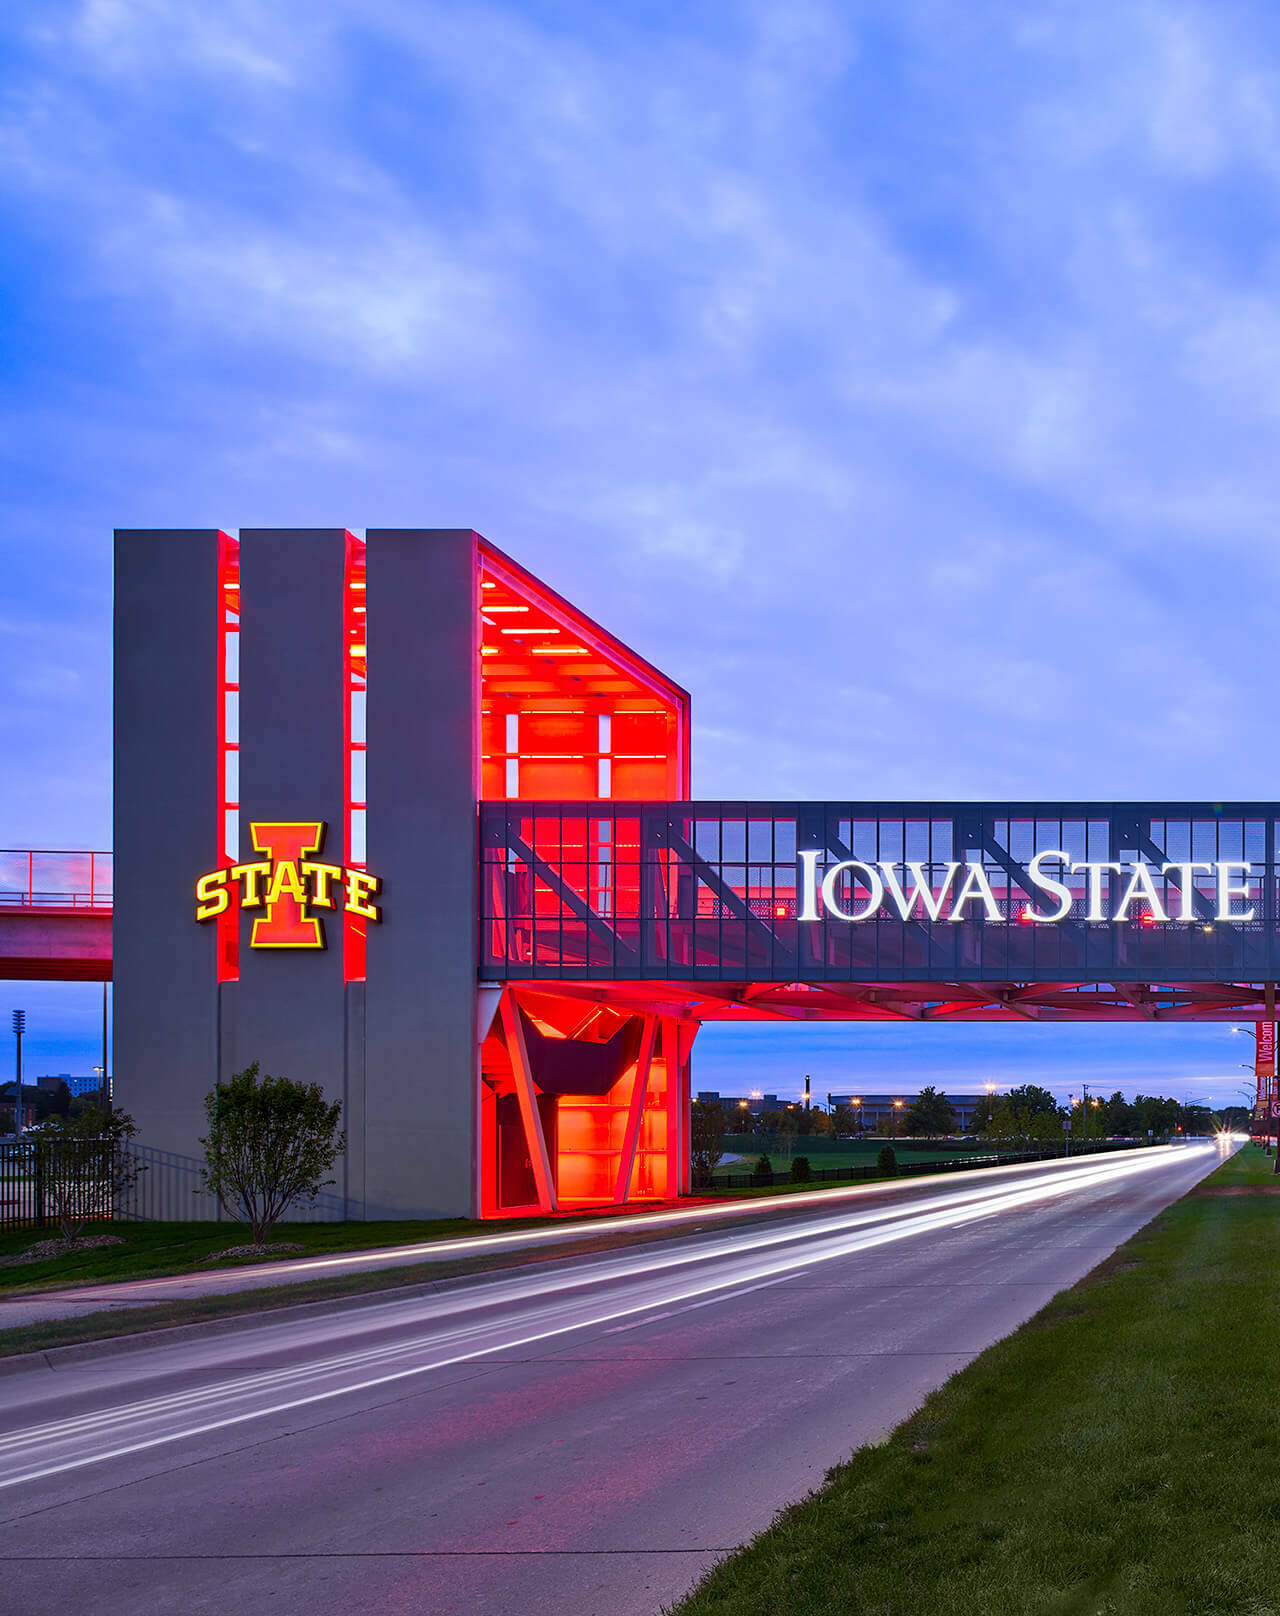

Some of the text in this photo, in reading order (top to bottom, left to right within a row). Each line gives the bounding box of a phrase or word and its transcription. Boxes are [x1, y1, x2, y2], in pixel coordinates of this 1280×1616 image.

[196, 861, 378, 921] STATE
[796, 850, 1006, 922] IOWA
[1026, 850, 1256, 922] STATE
[1258, 1021, 1273, 1062] Welcom
